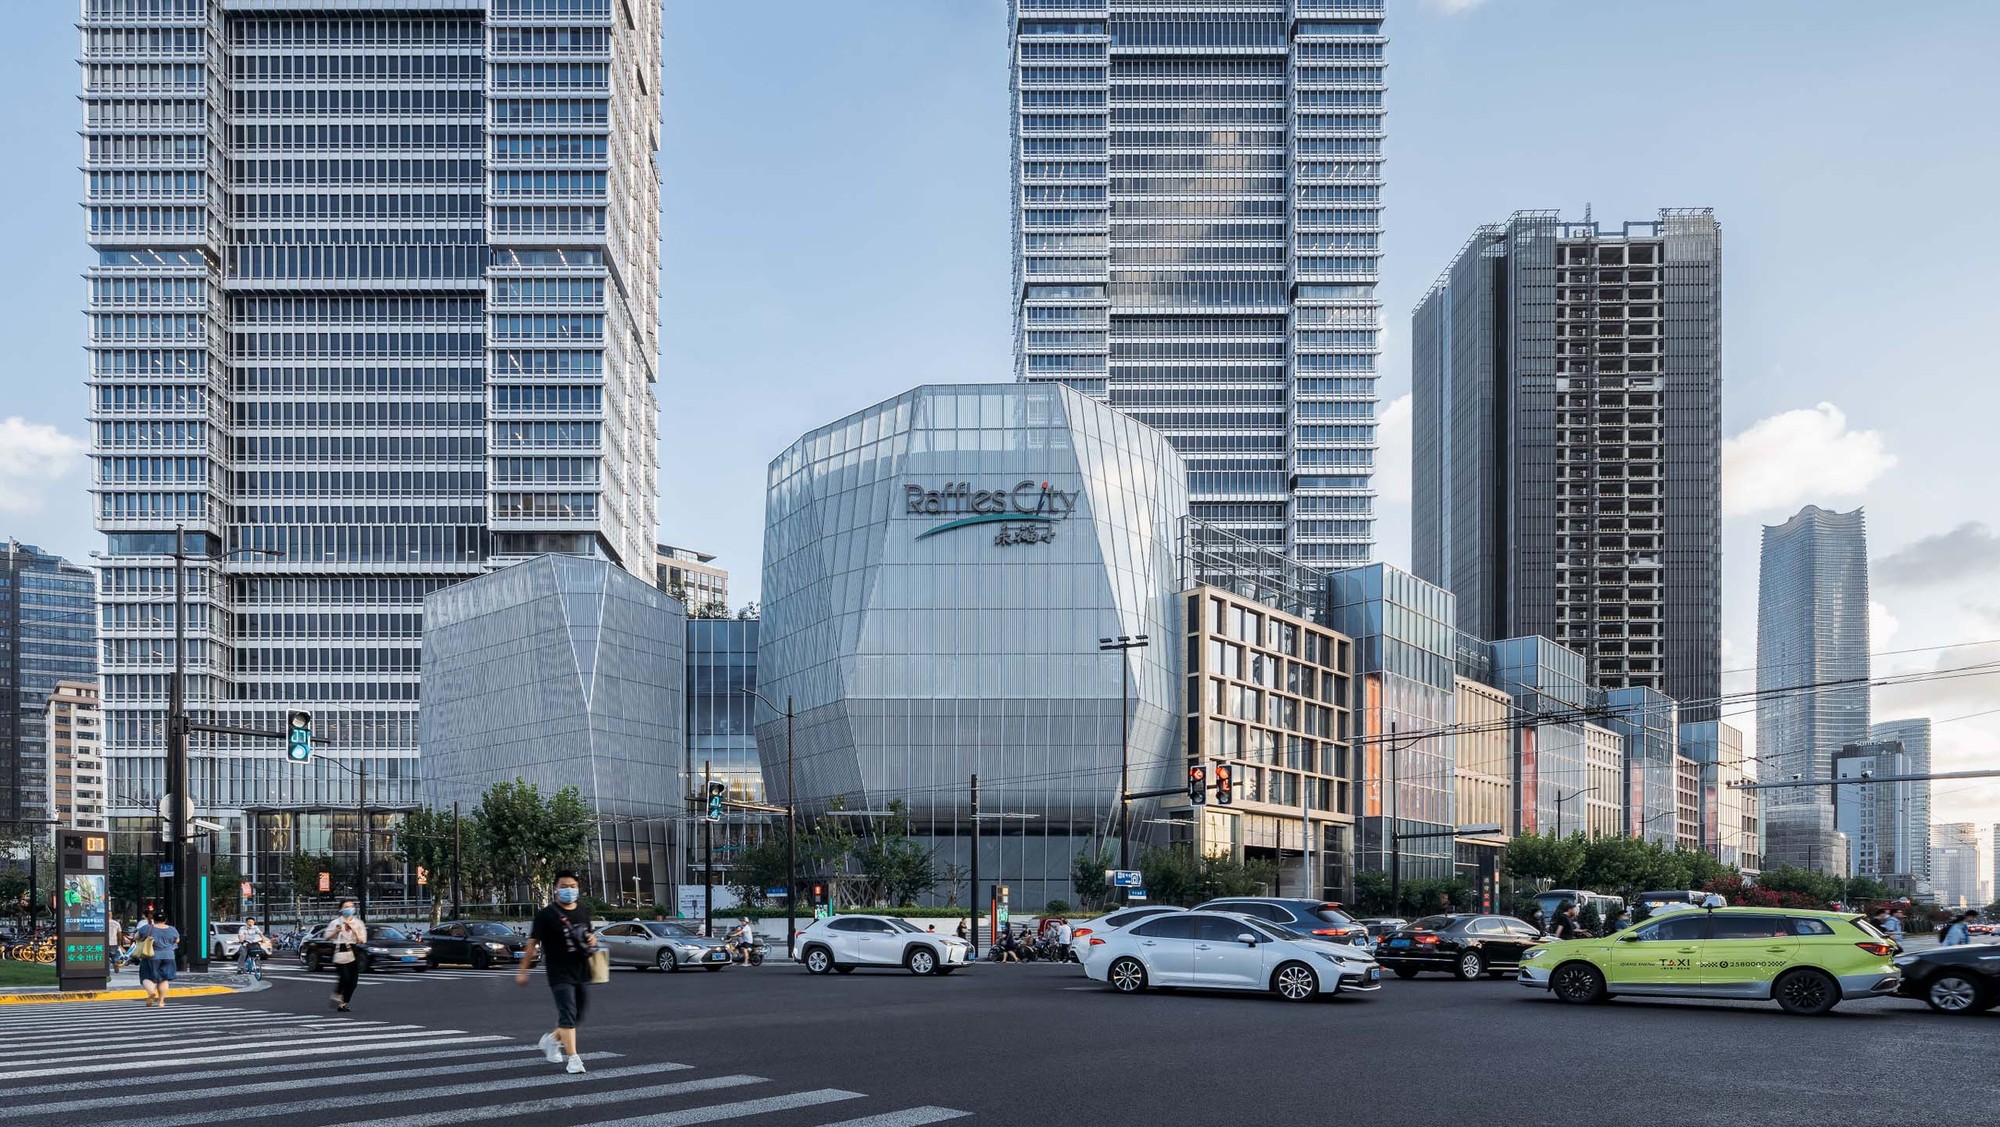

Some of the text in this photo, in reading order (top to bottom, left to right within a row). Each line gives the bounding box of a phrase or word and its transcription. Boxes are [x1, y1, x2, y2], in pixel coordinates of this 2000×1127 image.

[904, 480, 1081, 519] Raffles City
[291, 729, 306, 743] 07
[87, 837, 104, 851] 07
[67, 954, 104, 962] 安全出行
[1659, 958, 1690, 966] TAXI
